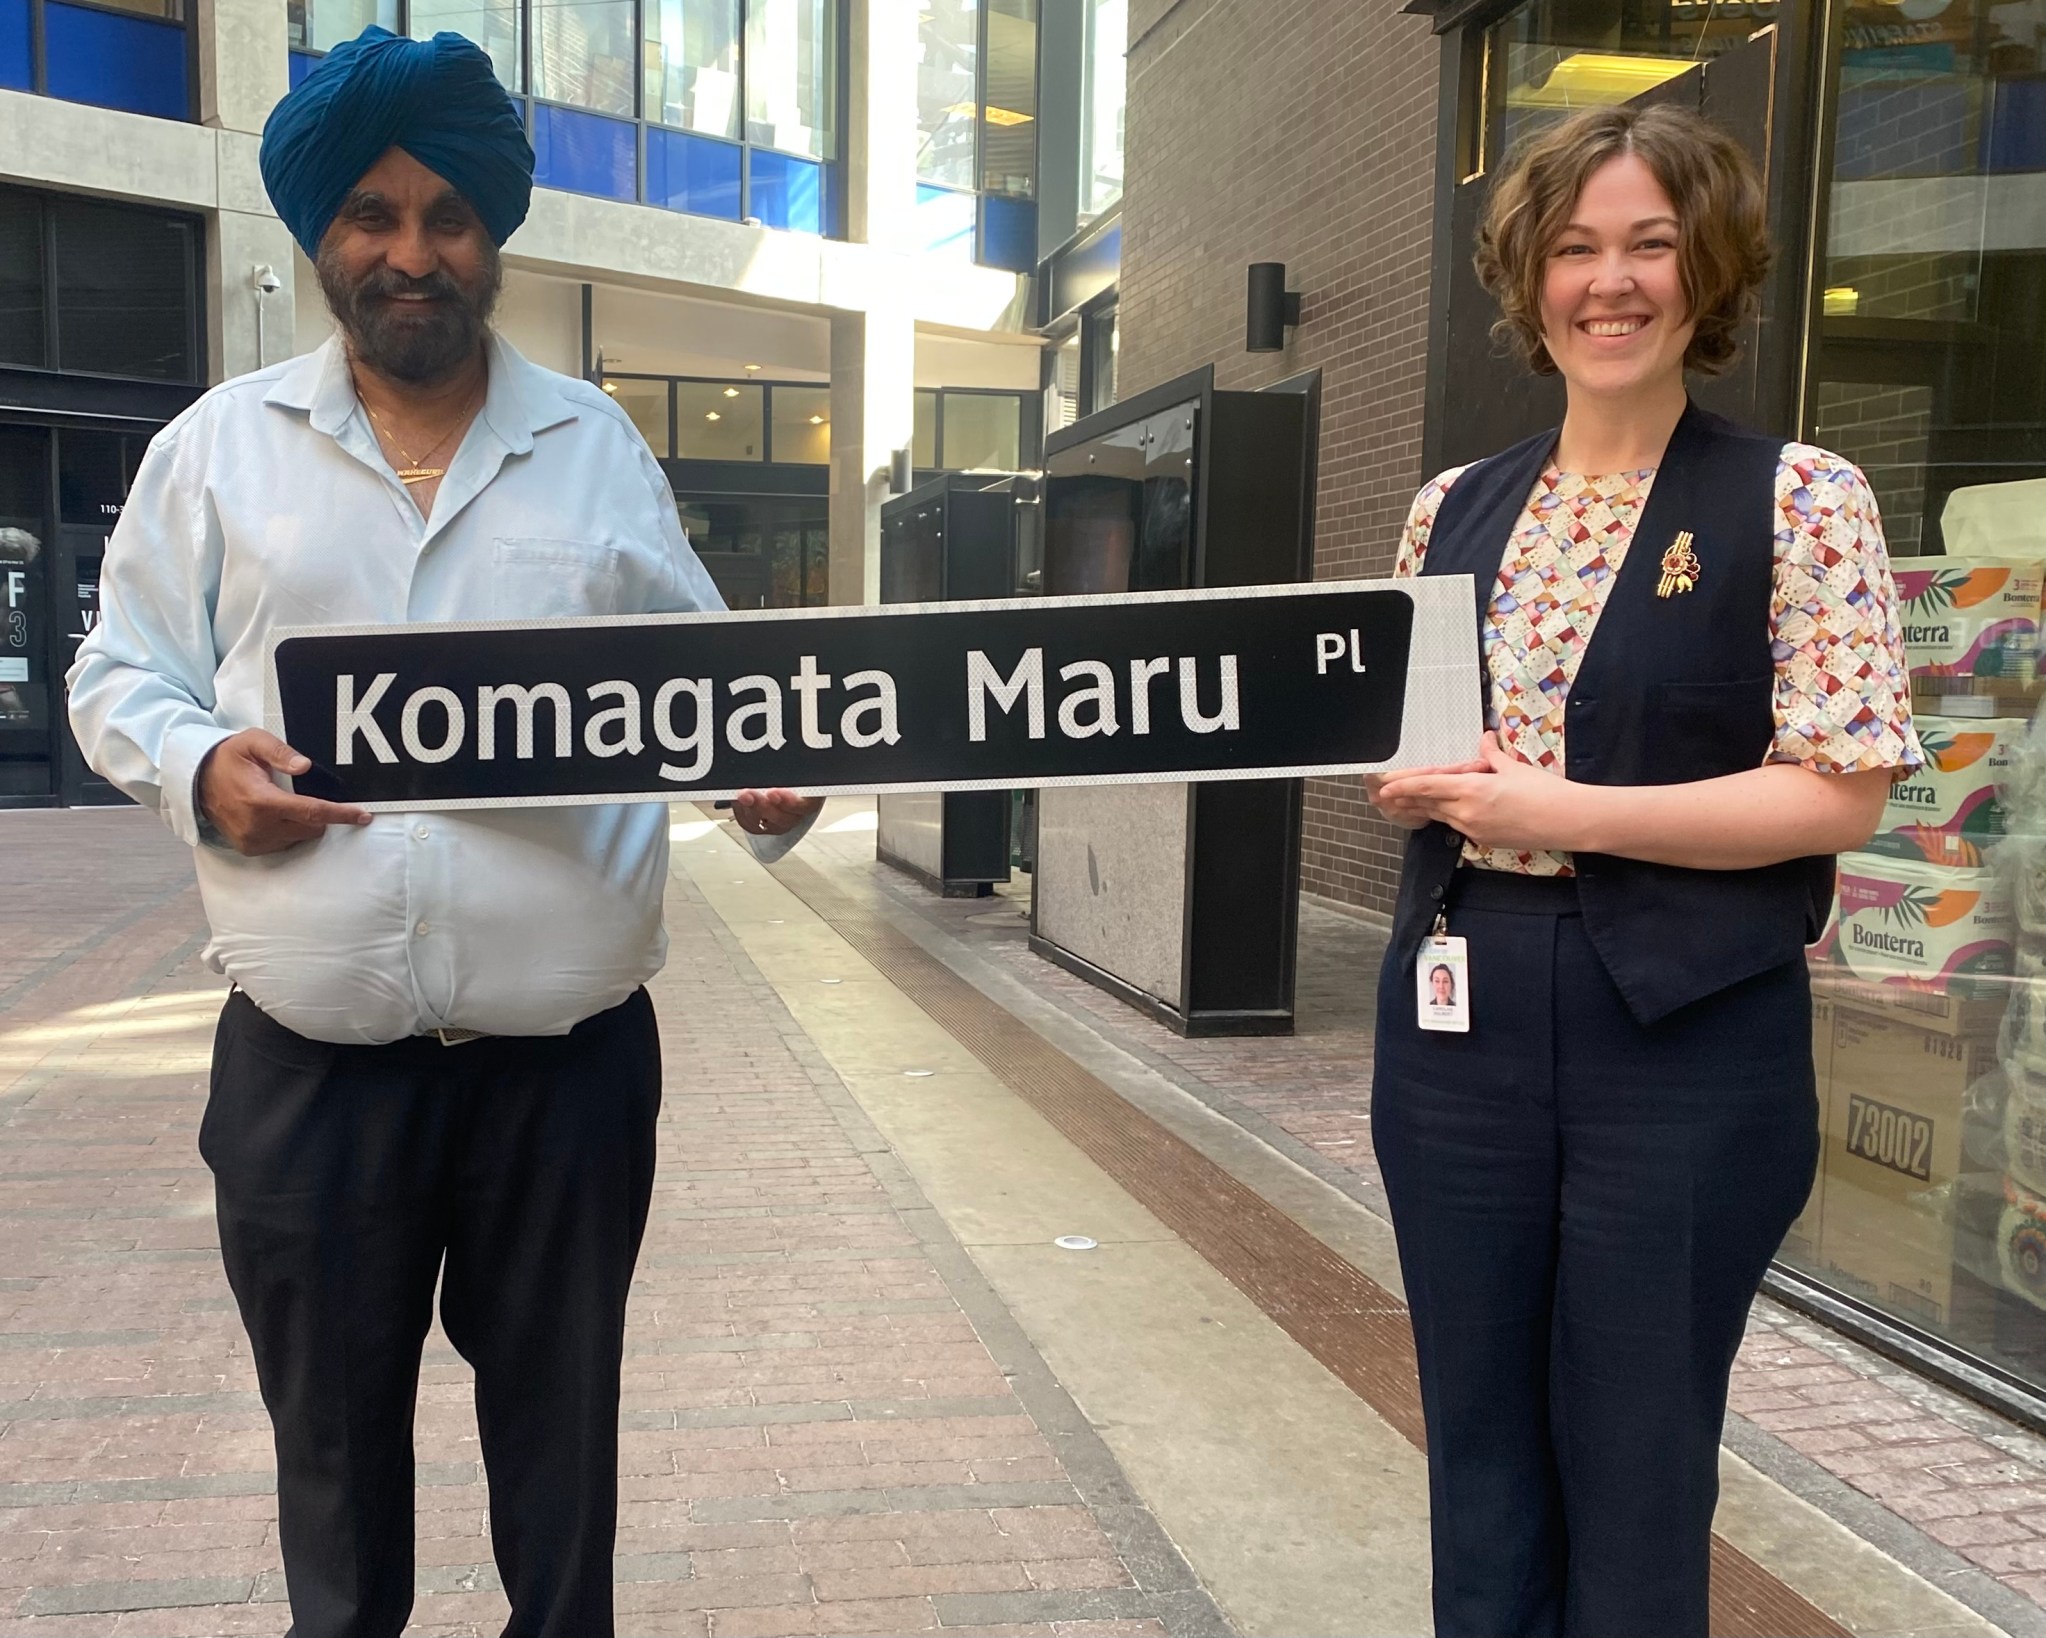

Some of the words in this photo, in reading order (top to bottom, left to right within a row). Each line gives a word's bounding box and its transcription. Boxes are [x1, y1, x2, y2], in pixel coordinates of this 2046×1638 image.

[1901, 623, 1950, 643] terra
[335, 655, 901, 782] Komagata
[966, 647, 1241, 742] Maru
[1315, 628, 1366, 675] Pl
[1889, 783, 1937, 805] terra
[1853, 924, 1924, 958] Bonterra
[1850, 1098, 1930, 1176] 73002
